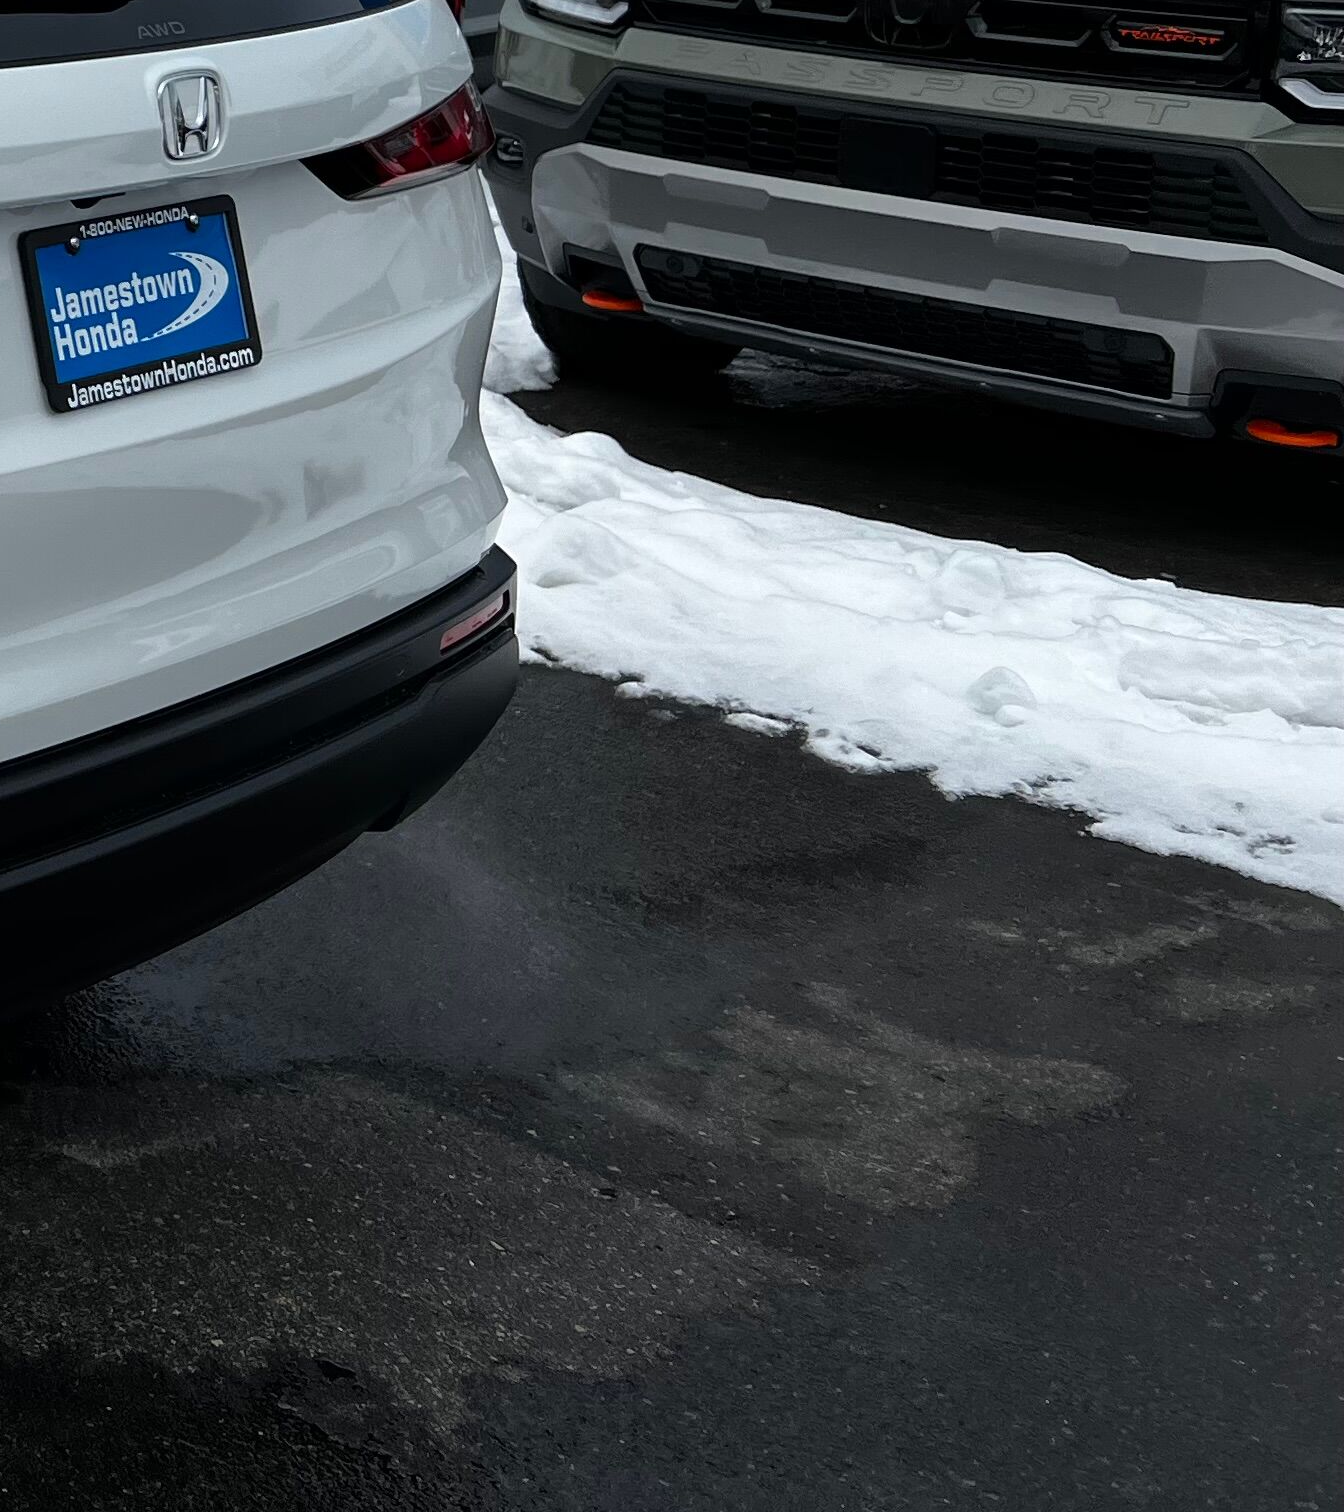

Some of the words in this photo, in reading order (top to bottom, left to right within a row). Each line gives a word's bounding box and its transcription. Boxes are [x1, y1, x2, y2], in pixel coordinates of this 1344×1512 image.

[136, 20, 187, 40] AWD
[665, 39, 1192, 126] PASSPORT
[78, 205, 191, 239] 1-800-NEW-HONDA
[50, 267, 194, 323] Jamestown
[53, 311, 139, 361] Honda
[67, 346, 255, 409] JamestownHonda.com
